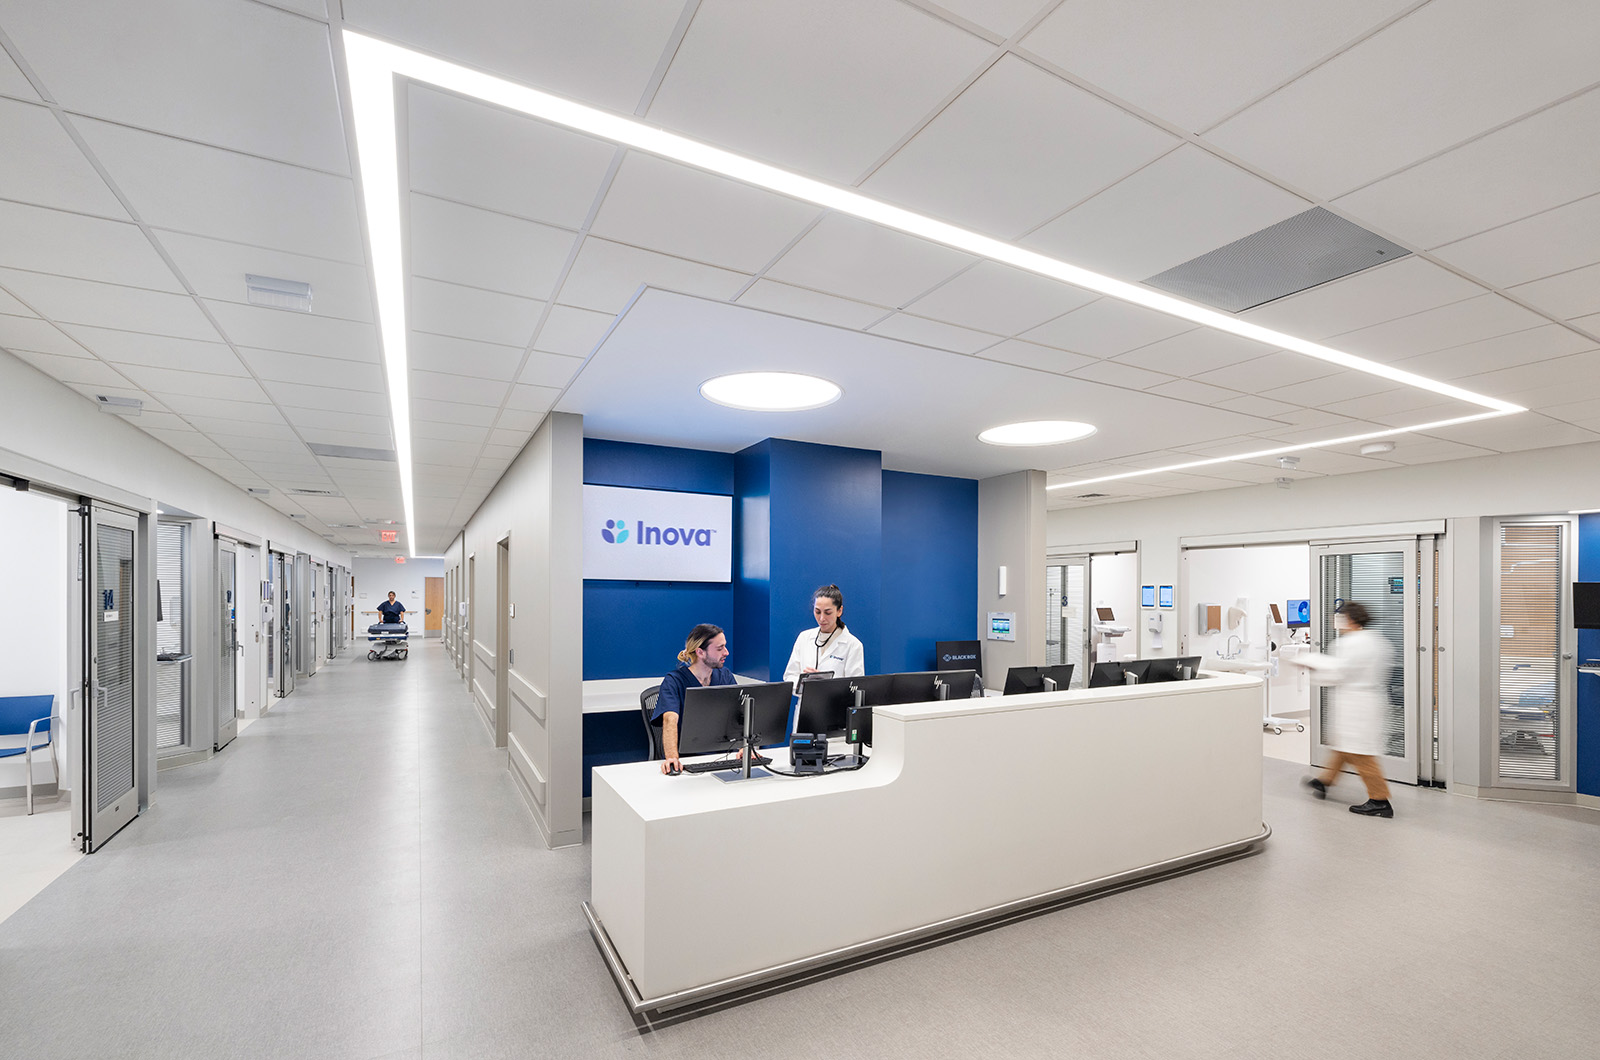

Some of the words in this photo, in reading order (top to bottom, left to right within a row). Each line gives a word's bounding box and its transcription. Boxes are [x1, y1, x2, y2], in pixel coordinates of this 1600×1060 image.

[381, 531, 397, 542] EXIT
[102, 589, 114, 610] 14
[1061, 595, 1068, 607] 3
[1334, 598, 1345, 613] 2
